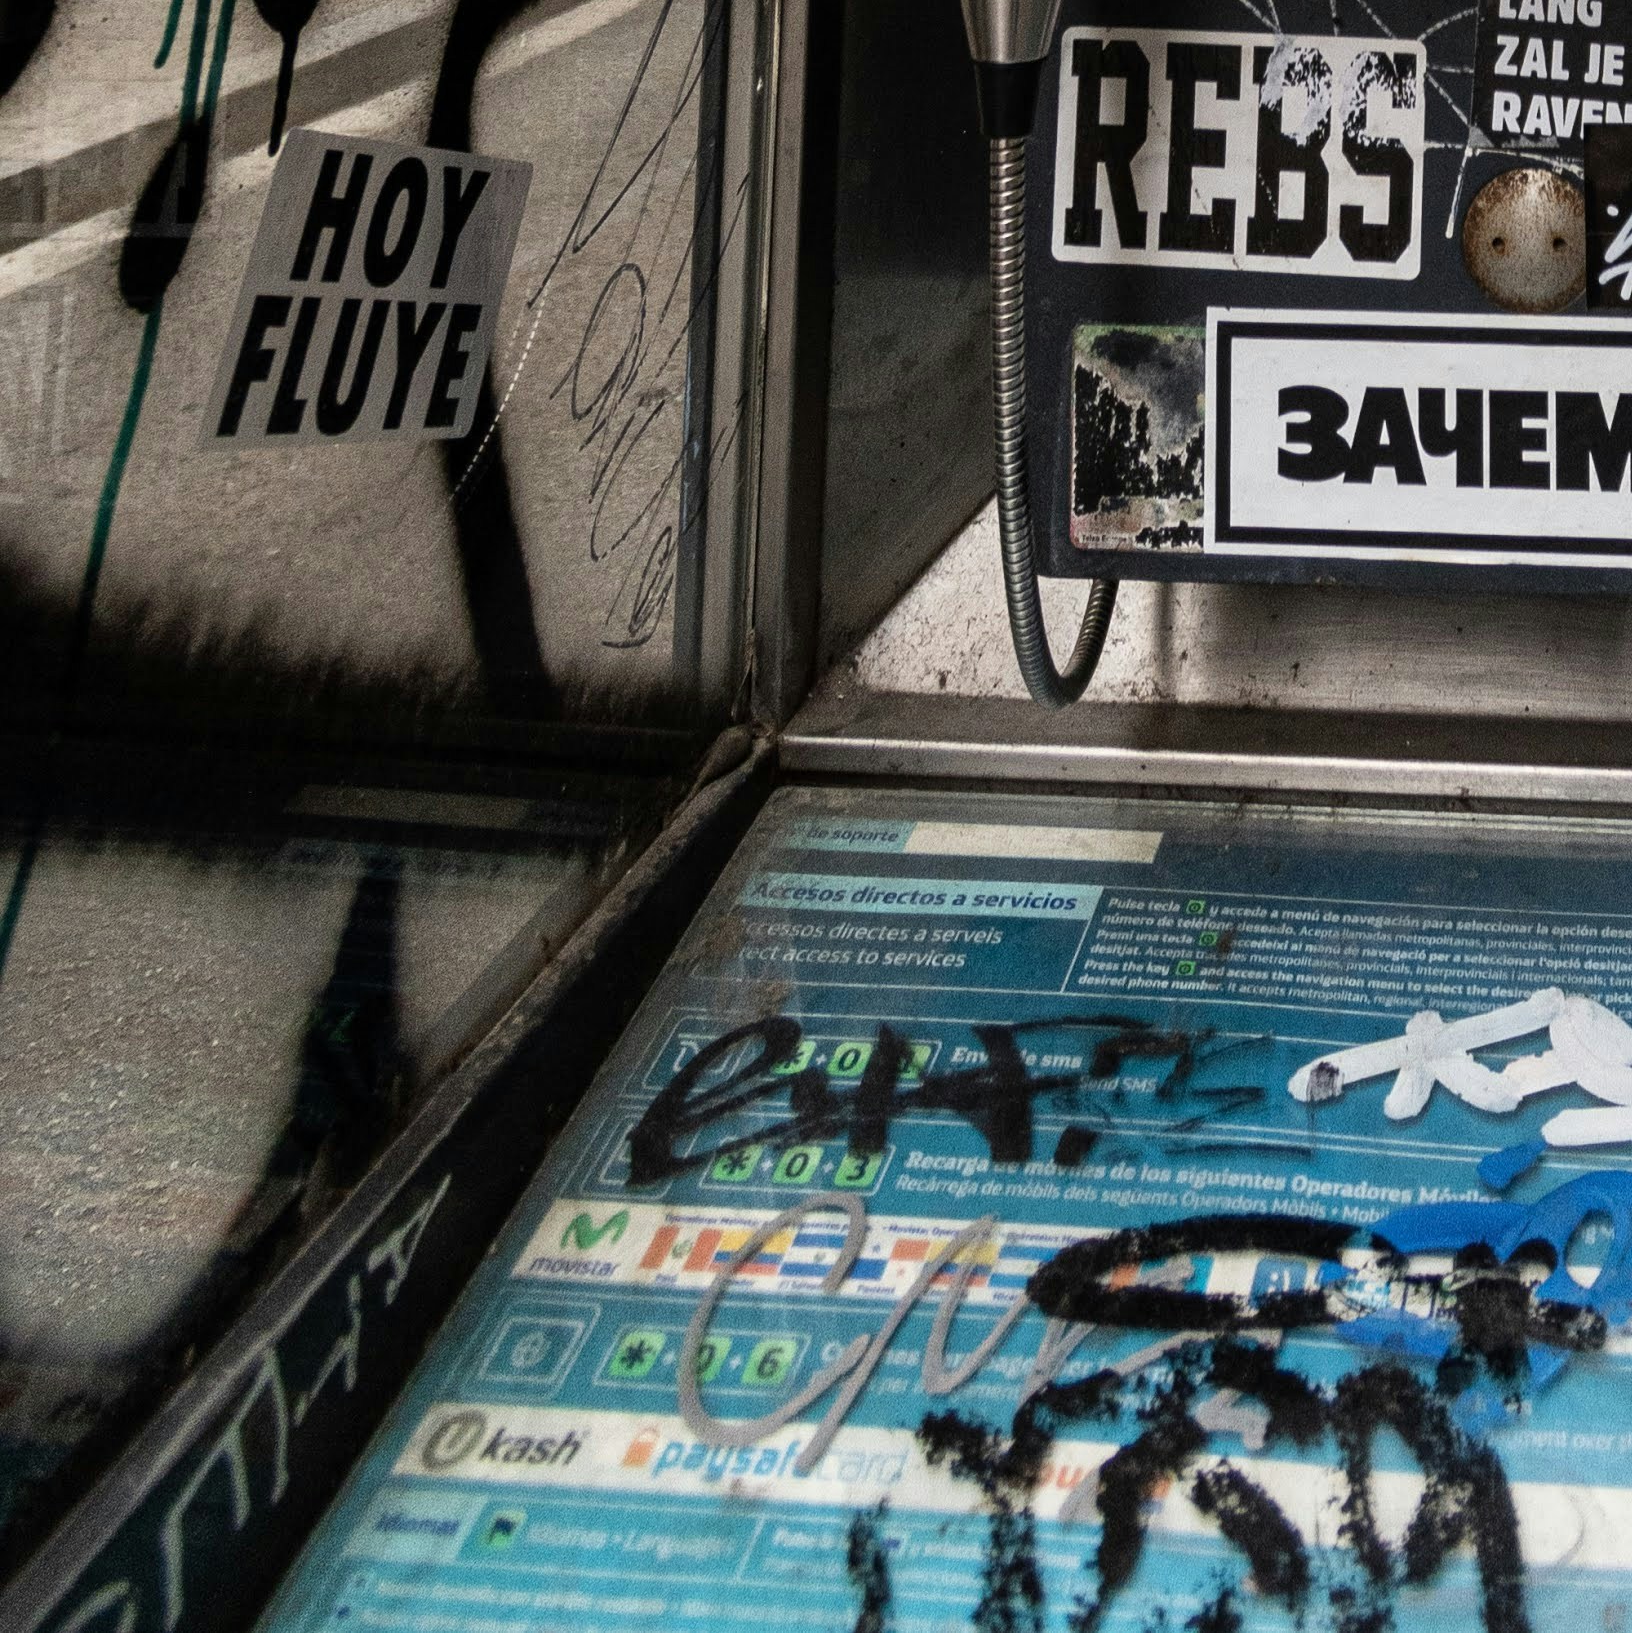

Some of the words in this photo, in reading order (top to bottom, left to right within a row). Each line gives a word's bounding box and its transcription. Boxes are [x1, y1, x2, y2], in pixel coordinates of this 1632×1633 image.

[1493, 35, 1571, 83] ZAL
[1583, 43, 1626, 87] JE
[1064, 38, 1418, 264] REBS
[289, 148, 492, 290] HOY
[215, 294, 484, 437] FLUYE
[832, 827, 899, 845] soporte
[753, 882, 846, 903] Accesos
[850, 883, 950, 906] directos
[952, 893, 965, 906] a
[972, 890, 1077, 911] servicios
[828, 922, 909, 941] directes
[913, 929, 925, 942] a
[930, 928, 1003, 945] serveis
[1108, 897, 1144, 910] Pulse
[1148, 899, 1180, 912] tecla
[1280, 907, 1320, 921] menú
[1322, 909, 1340, 922] de
[1342, 910, 1419, 930] navegación
[1421, 918, 1452, 932] para
[1455, 917, 1532, 933] seleccionar
[1536, 922, 1548, 934] la
[1551, 923, 1596, 940] opción
[782, 948, 858, 964] access
[859, 948, 878, 965] to
[884, 948, 966, 968] services
[1041, 1053, 1083, 1069] sms
[904, 1148, 988, 1176] Recarga
[1111, 1161, 1136, 1180] de
[1141, 1163, 1171, 1182] los
[1176, 1167, 1286, 1190] siguientes
[1291, 1176, 1412, 1202] Operadores
[981, 1178, 1001, 1196] de
[1063, 1183, 1096, 1202] dels
[1182, 1189, 1266, 1212] Operadors
[529, 1254, 622, 1277] movistar
